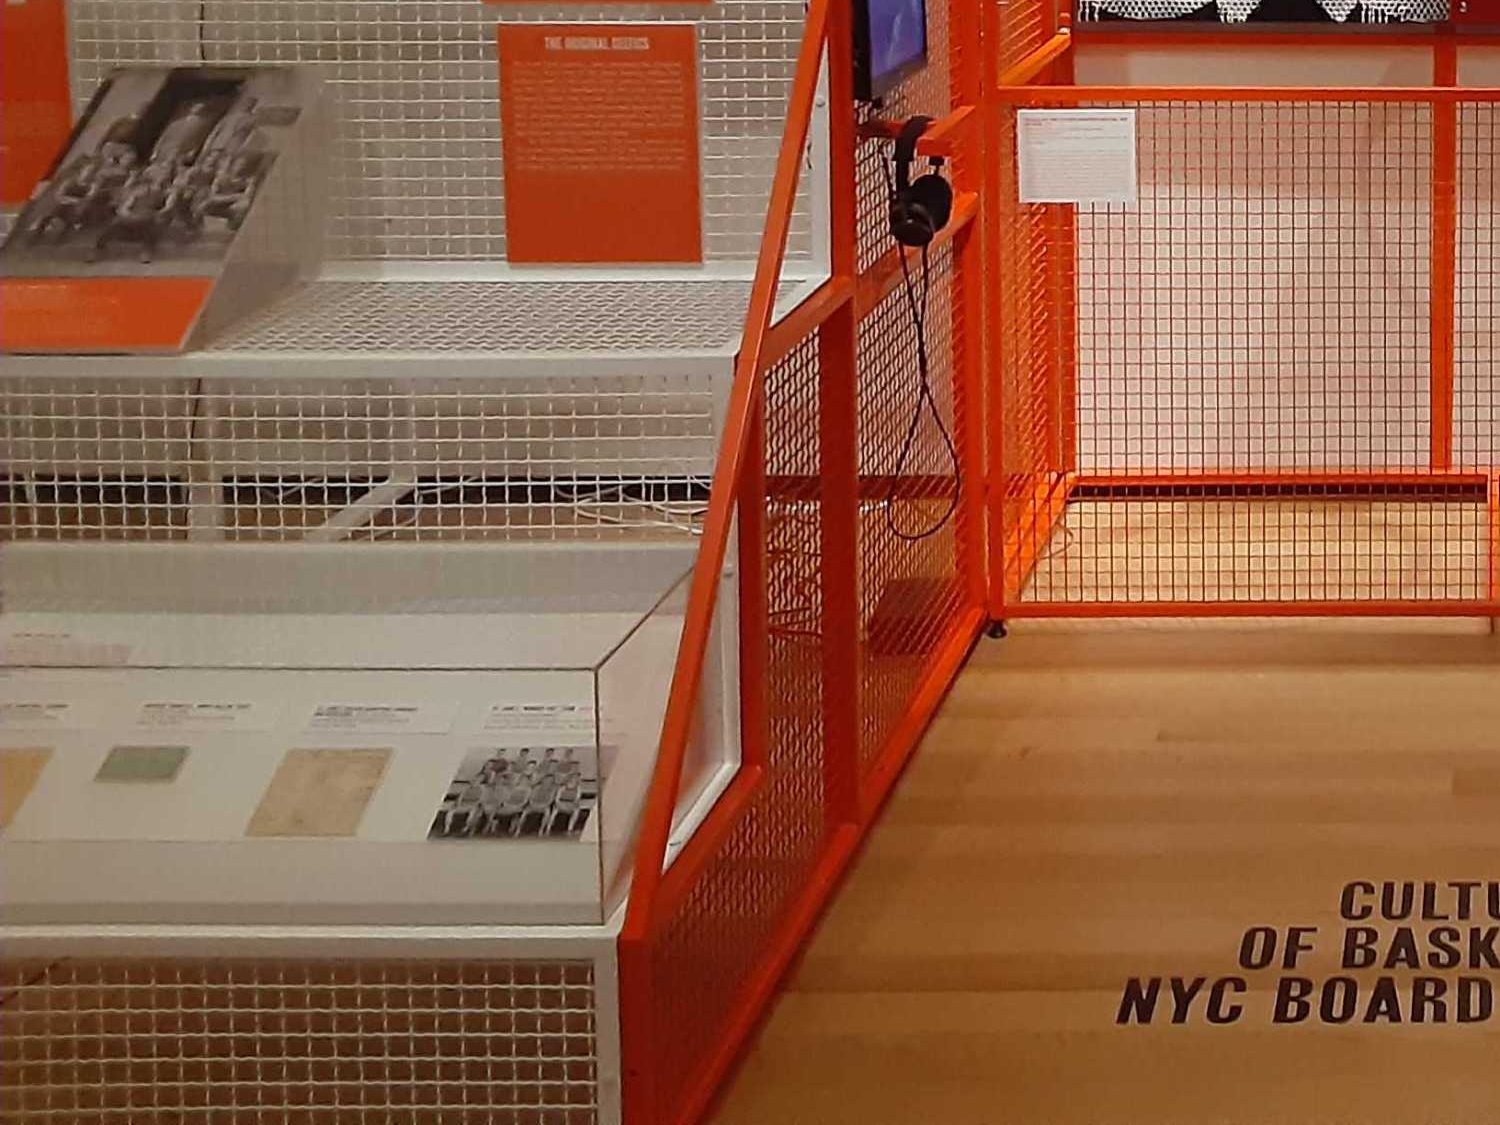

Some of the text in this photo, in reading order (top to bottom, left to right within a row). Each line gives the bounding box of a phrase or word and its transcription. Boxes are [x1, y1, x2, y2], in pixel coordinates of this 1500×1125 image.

[1237, 925, 1318, 971] OF
[1115, 976, 1248, 1025] NYC
[1272, 976, 1494, 1025] BOARD
